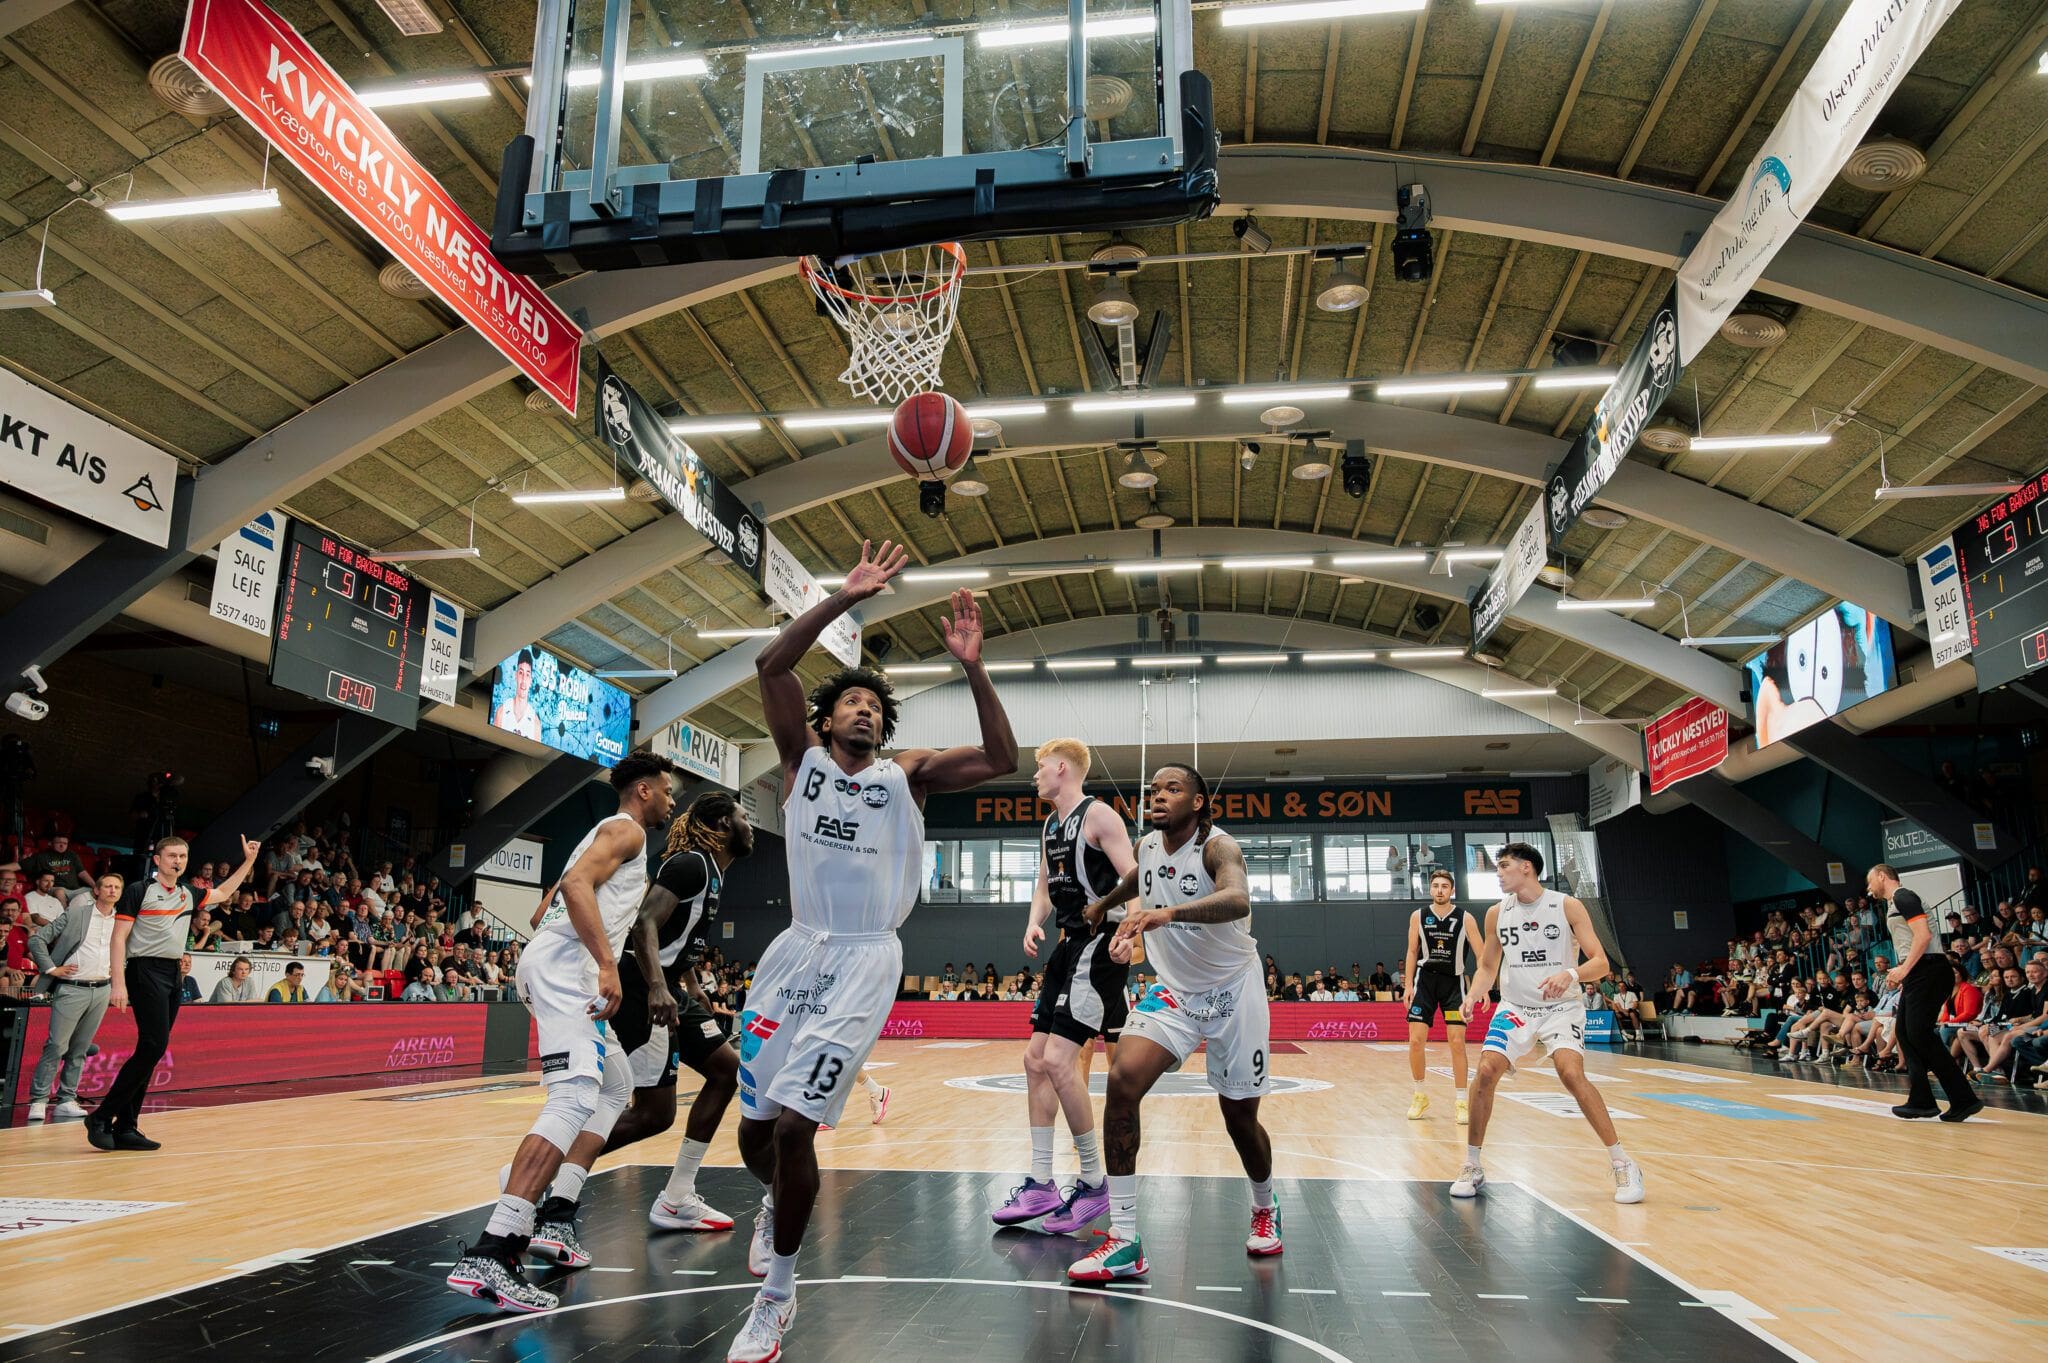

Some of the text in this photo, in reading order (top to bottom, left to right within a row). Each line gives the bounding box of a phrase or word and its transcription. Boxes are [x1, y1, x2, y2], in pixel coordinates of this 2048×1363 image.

[267, 44, 549, 347] KVICKLY NÆSTVED
[260, 87, 354, 186] Kvægtorvet
[357, 179, 367, 196] 8
[377, 200, 413, 241] 4700
[416, 238, 466, 294] Næstved
[491, 307, 505, 328] 55
[507, 320, 519, 341] 70
[521, 334, 531, 352] 71
[532, 346, 546, 366] 00
[0, 413, 107, 485] KT A/S
[1571, 389, 1650, 516] #TEAMFOAESTVED
[638, 446, 734, 553] #TEAMFOAESTVED
[2009, 481, 2039, 513] BAKKEN
[2004, 524, 2015, 553] 5
[234, 549, 265, 575] SALG
[322, 568, 329, 579] H
[355, 554, 383, 580] BAKKEN
[232, 573, 261, 598] LEJE
[342, 572, 352, 595] 5
[388, 595, 398, 616] 3
[1934, 587, 1957, 612] SALG
[216, 602, 240, 620] 5577
[242, 613, 266, 630] 4030
[1938, 610, 1960, 633] LEJE
[387, 629, 396, 647] 0
[431, 638, 451, 658] SALG
[1936, 638, 1971, 663] 5577 4030
[430, 658, 449, 676] LEJE
[338, 678, 373, 708] 8:40
[559, 673, 588, 705] ROBIN
[1682, 708, 1725, 744] NÆSTVED
[595, 732, 623, 755] Garant
[802, 767, 826, 802] 13
[975, 796, 1053, 822] FRED
[1283, 792, 1306, 817] &
[1318, 790, 1392, 818] SØN
[1464, 789, 1521, 814] FAS
[814, 814, 860, 841] FAS
[1064, 814, 1080, 841] 18
[814, 838, 853, 852] ANDERSEN
[1144, 869, 1152, 896] 9
[1448, 917, 1458, 933] 7
[1500, 926, 1519, 946] 55
[251, 961, 281, 972] ÆSTVED
[1521, 949, 1546, 962] FAS
[880, 1028, 923, 1036] STVED
[887, 1020, 923, 1028] ENA
[1306, 1030, 1378, 1038] NÆSTVED
[1311, 1021, 1378, 1030] ARENA
[391, 1035, 455, 1053] ARENA
[385, 1050, 454, 1067] NÆSTVED
[1252, 1048, 1264, 1077] 9
[807, 1052, 844, 1093] 13
